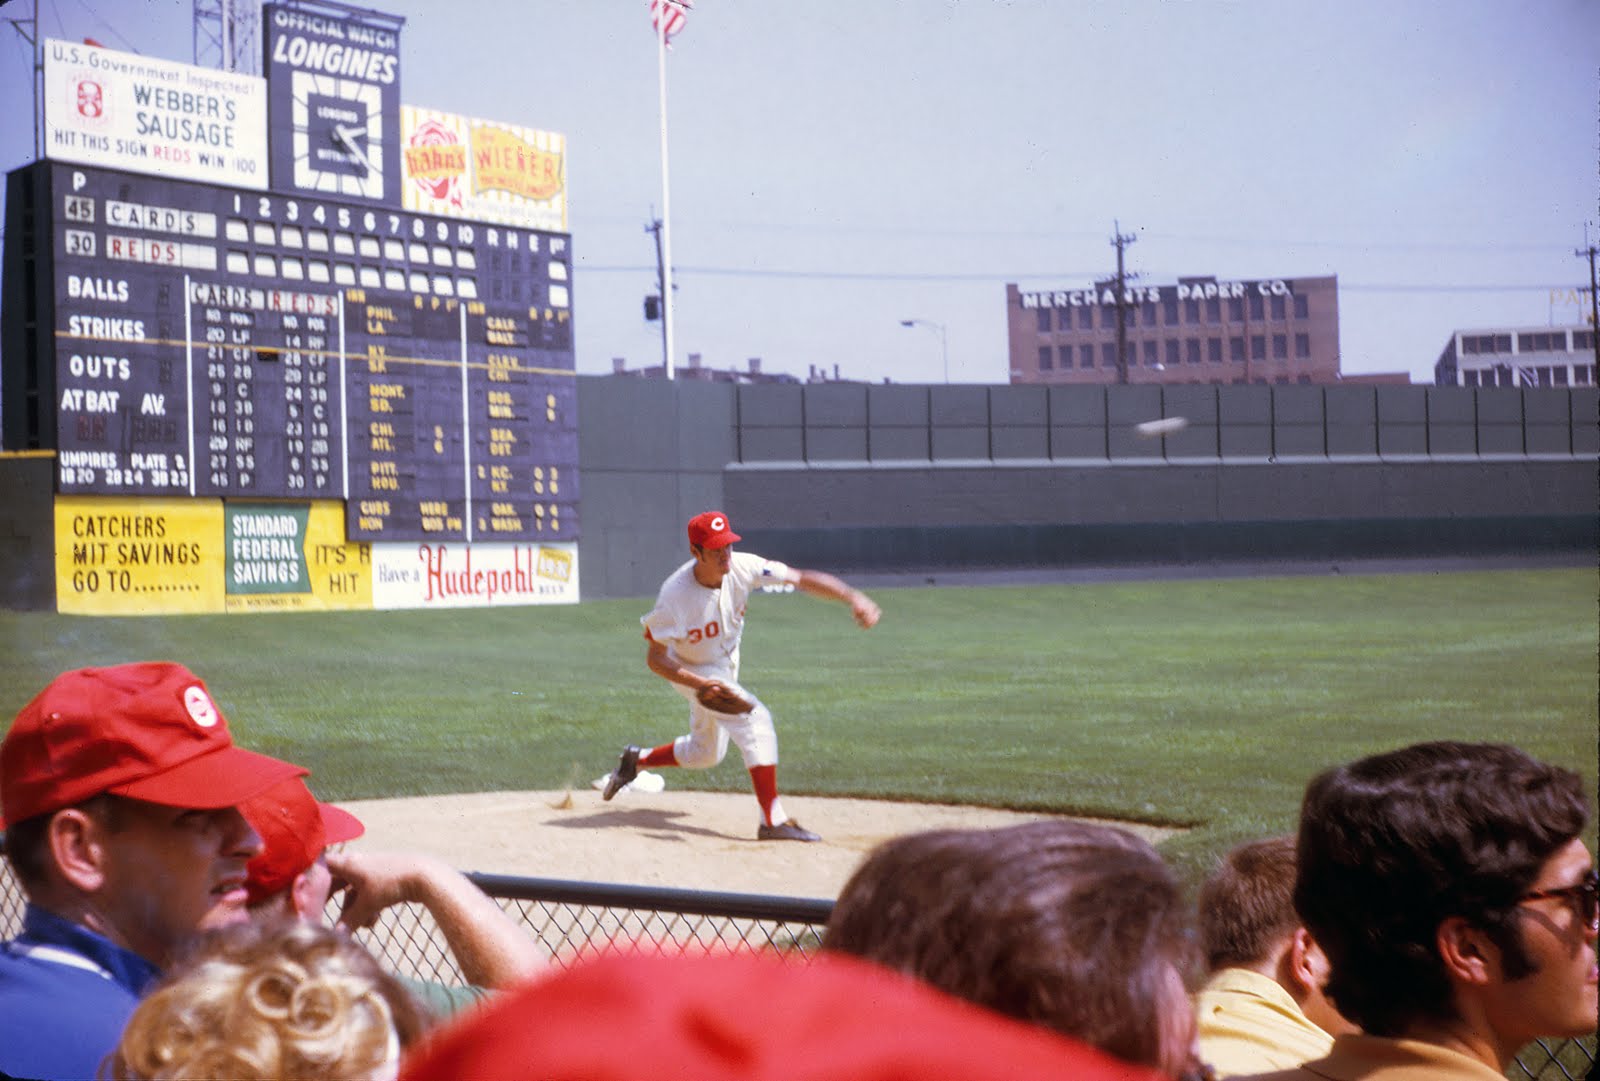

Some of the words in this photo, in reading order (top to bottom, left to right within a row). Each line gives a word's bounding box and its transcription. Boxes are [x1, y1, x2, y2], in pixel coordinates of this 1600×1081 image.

[275, 10, 345, 39] OFFICIAL
[347, 25, 396, 48] WATCH
[53, 46, 84, 65] U.S.
[273, 34, 398, 84] LONGINES
[134, 83, 236, 121] WEBBER'S
[136, 112, 234, 148] SAUSAGE
[55, 129, 76, 146] HIT
[81, 134, 110, 151] THIS
[116, 139, 148, 156] SIGN
[153, 145, 191, 162] REDS
[198, 153, 225, 168] WIN
[68, 200, 91, 218] 45
[112, 204, 195, 231] CARDS
[72, 171, 87, 191] P
[234, 194, 241, 214] 1
[259, 197, 271, 218] 2
[287, 201, 298, 221] 3
[313, 205, 326, 225] 4
[338, 208, 350, 228] 5
[364, 212, 376, 232] 6
[389, 215, 400, 235] 7
[413, 218, 425, 238] 8
[437, 222, 449, 241] 9
[458, 224, 474, 245] 10
[487, 228, 499, 247] R
[507, 231, 518, 250] H
[529, 234, 539, 252] E
[71, 234, 92, 251] 30
[112, 239, 175, 263] REDS
[68, 276, 128, 301] BALLS
[195, 284, 251, 308] CARDS
[273, 291, 333, 314] REDS
[1023, 287, 1160, 309] MERCHANTS
[1177, 281, 1247, 300] PAPER
[69, 316, 144, 341] STRIKES
[70, 355, 130, 379] OUTS
[61, 389, 83, 411] AT
[86, 390, 119, 413] BAT
[238, 383, 248, 398] C
[313, 404, 323, 419] C
[60, 451, 117, 468] UMPIRES
[131, 453, 167, 470] PLATE
[77, 468, 95, 484] 20
[73, 516, 166, 538] CATCHERS
[233, 515, 298, 537] STANDARD
[711, 517, 725, 531] C
[74, 543, 109, 565] MIT
[118, 543, 200, 565] SAVINGS
[233, 538, 299, 561] FEDERAL
[316, 544, 347, 565] IT'S
[73, 570, 99, 593] GO
[233, 561, 299, 584] SAVINGS
[330, 573, 359, 593] HIT
[379, 563, 409, 583] Have
[413, 569, 420, 582] a
[419, 544, 534, 601] Hudepohl
[688, 621, 719, 644] 30
